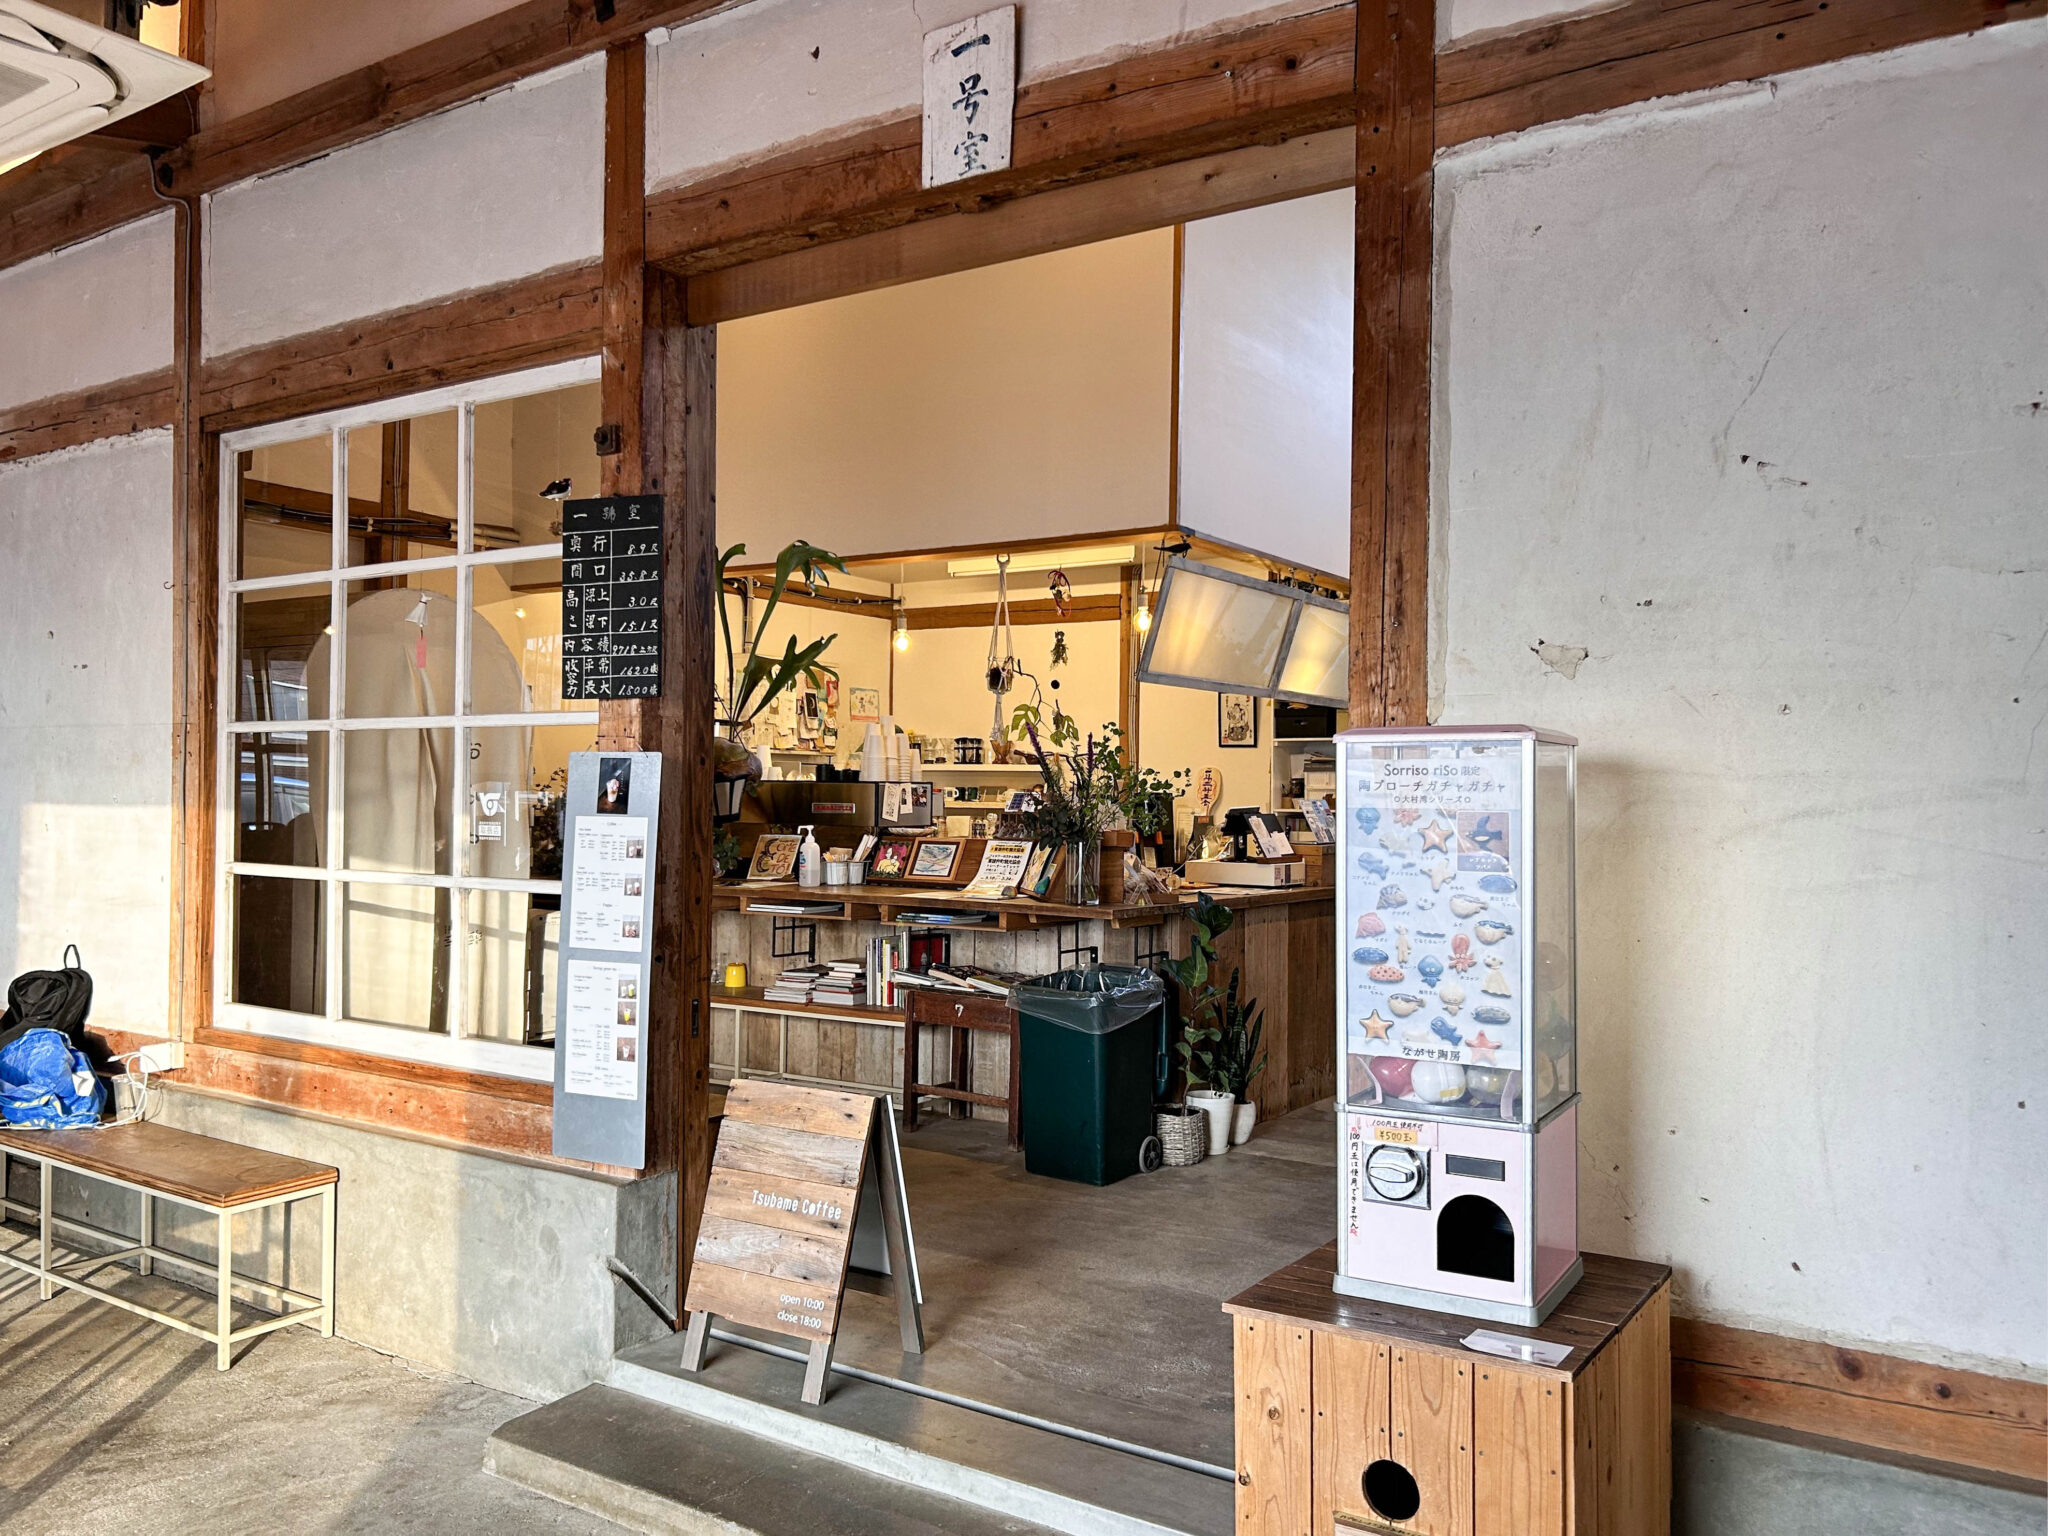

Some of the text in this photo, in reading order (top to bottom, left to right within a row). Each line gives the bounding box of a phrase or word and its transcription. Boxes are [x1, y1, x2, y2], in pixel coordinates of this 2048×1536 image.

[951, 34, 991, 176] 一号室
[571, 563, 606, 579] 間口
[585, 588, 610, 603] 梁上
[566, 589, 579, 628] 高さ
[585, 614, 608, 629] 梁下
[564, 636, 610, 653] 内容積
[585, 657, 610, 673] 平常
[585, 680, 611, 695] 最大
[1384, 763, 1429, 776] Sorriso
[1433, 765, 1458, 776] riSo
[1358, 779, 1506, 792] 陶ブローチガチャガチャ
[1402, 1046, 1461, 1062] ながせ陶房
[751, 1190, 842, 1220] Tsubame Coffee
[780, 1293, 825, 1311] open 10:00
[777, 1309, 822, 1329] close 18:00
